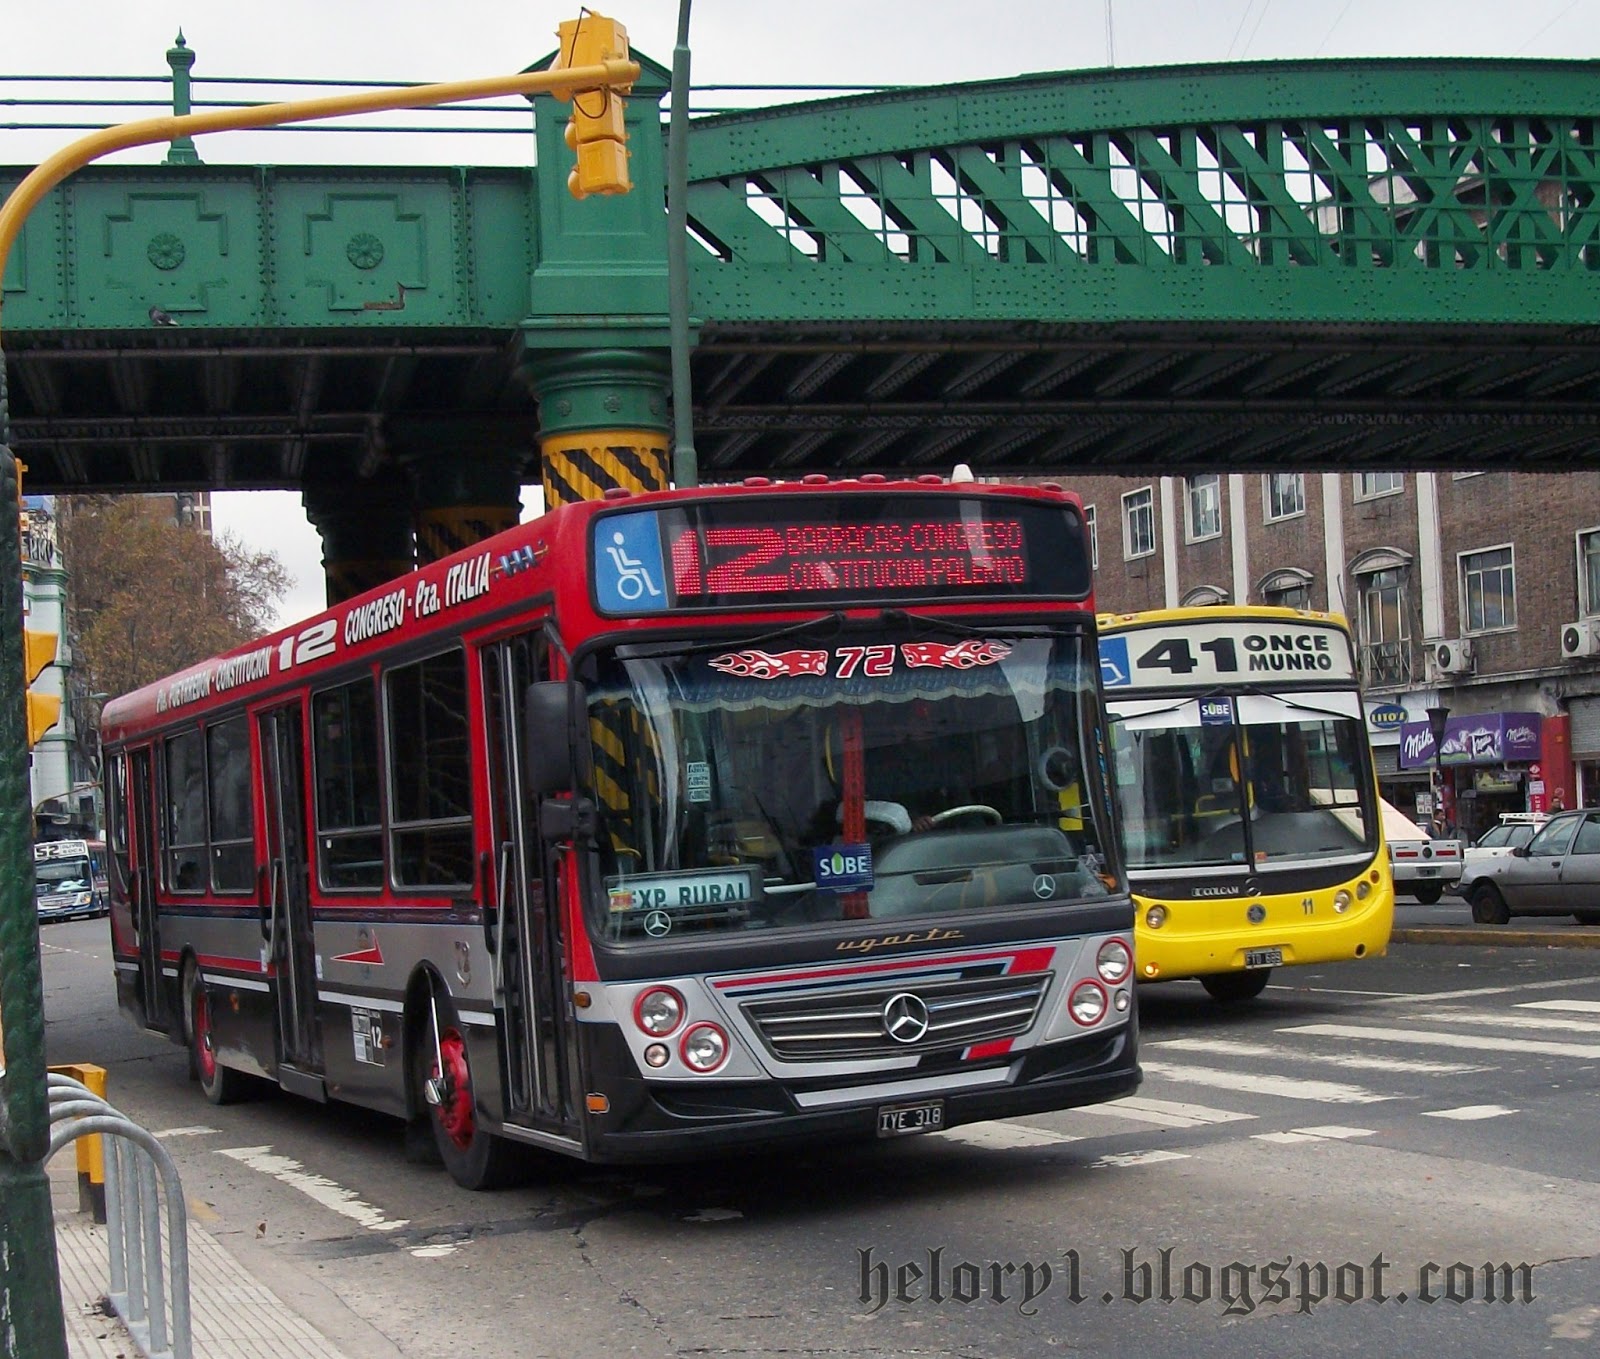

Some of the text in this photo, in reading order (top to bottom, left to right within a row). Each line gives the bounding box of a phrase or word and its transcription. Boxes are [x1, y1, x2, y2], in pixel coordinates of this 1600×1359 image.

[672, 527, 788, 597] 12
[215, 645, 272, 692] CONSTITUCION
[277, 618, 338, 672] 12
[344, 587, 406, 646] CONGRESO
[414, 579, 441, 618] Pza.
[445, 551, 491, 608] ITALIA
[835, 644, 896, 680] 72
[1136, 634, 1330, 674] 41 ONCE
[1249, 652, 1332, 672] MUNRO
[1201, 702, 1231, 716] SUBE
[819, 852, 869, 877] SUBE
[679, 882, 749, 906] RURAL
[1302, 898, 1314, 915] 11
[836, 927, 966, 953] ugarte
[371, 1025, 383, 1049] 12
[881, 1107, 942, 1131] IYE 318
